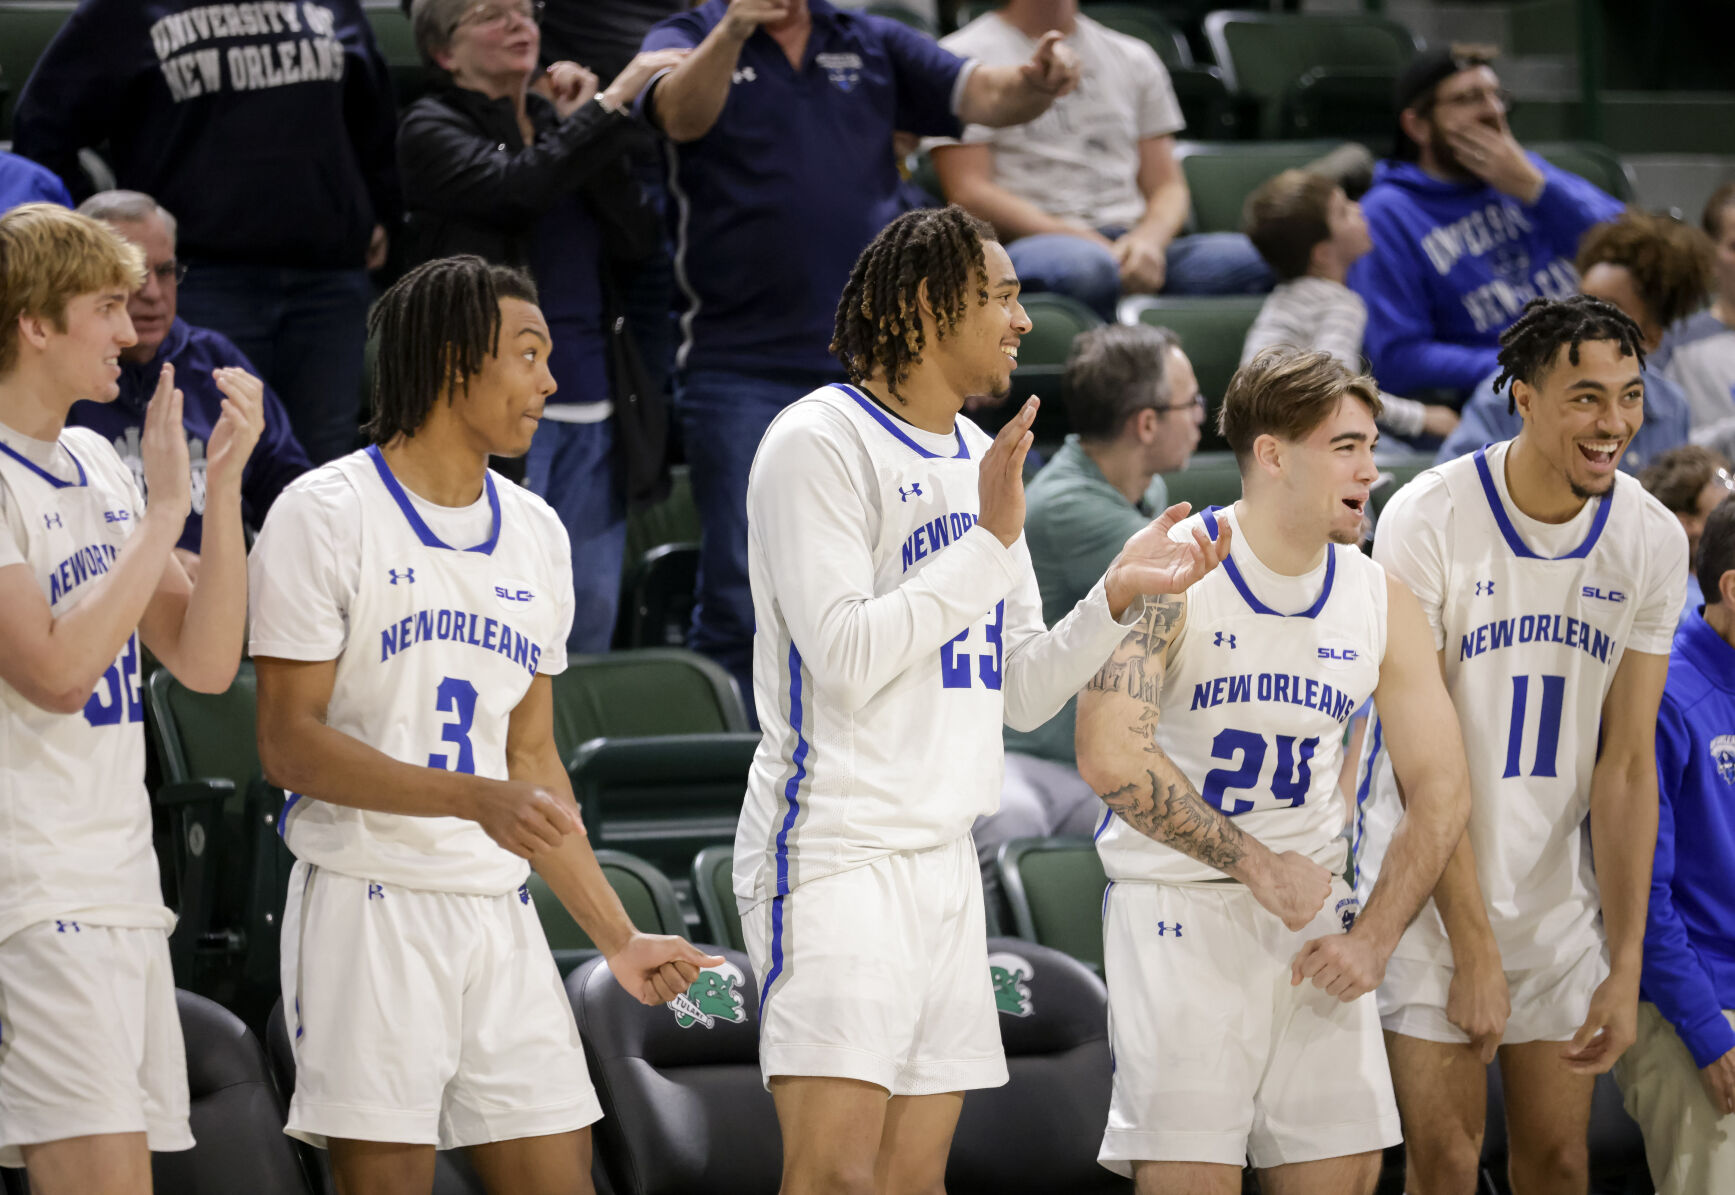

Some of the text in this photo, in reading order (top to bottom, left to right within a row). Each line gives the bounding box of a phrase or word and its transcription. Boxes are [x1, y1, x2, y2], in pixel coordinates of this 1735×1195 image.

[150, 2, 302, 60] UNIVERSITY
[160, 38, 345, 103] NEW ORLEANS
[104, 510, 130, 523] SLC
[902, 514, 950, 575] NEW
[49, 549, 88, 607] NEW
[494, 586, 530, 601] SLC
[1582, 586, 1622, 602] SLC
[380, 609, 541, 677] NEW ORLEANS
[1317, 648, 1355, 661] SLC
[1460, 614, 1616, 665] NEW ORLEAN
[428, 676, 479, 775] 3
[1190, 674, 1253, 712] NEW
[1257, 673, 1355, 725] ORLEANS
[1502, 675, 1566, 779] 11
[1202, 728, 1320, 817] 24
